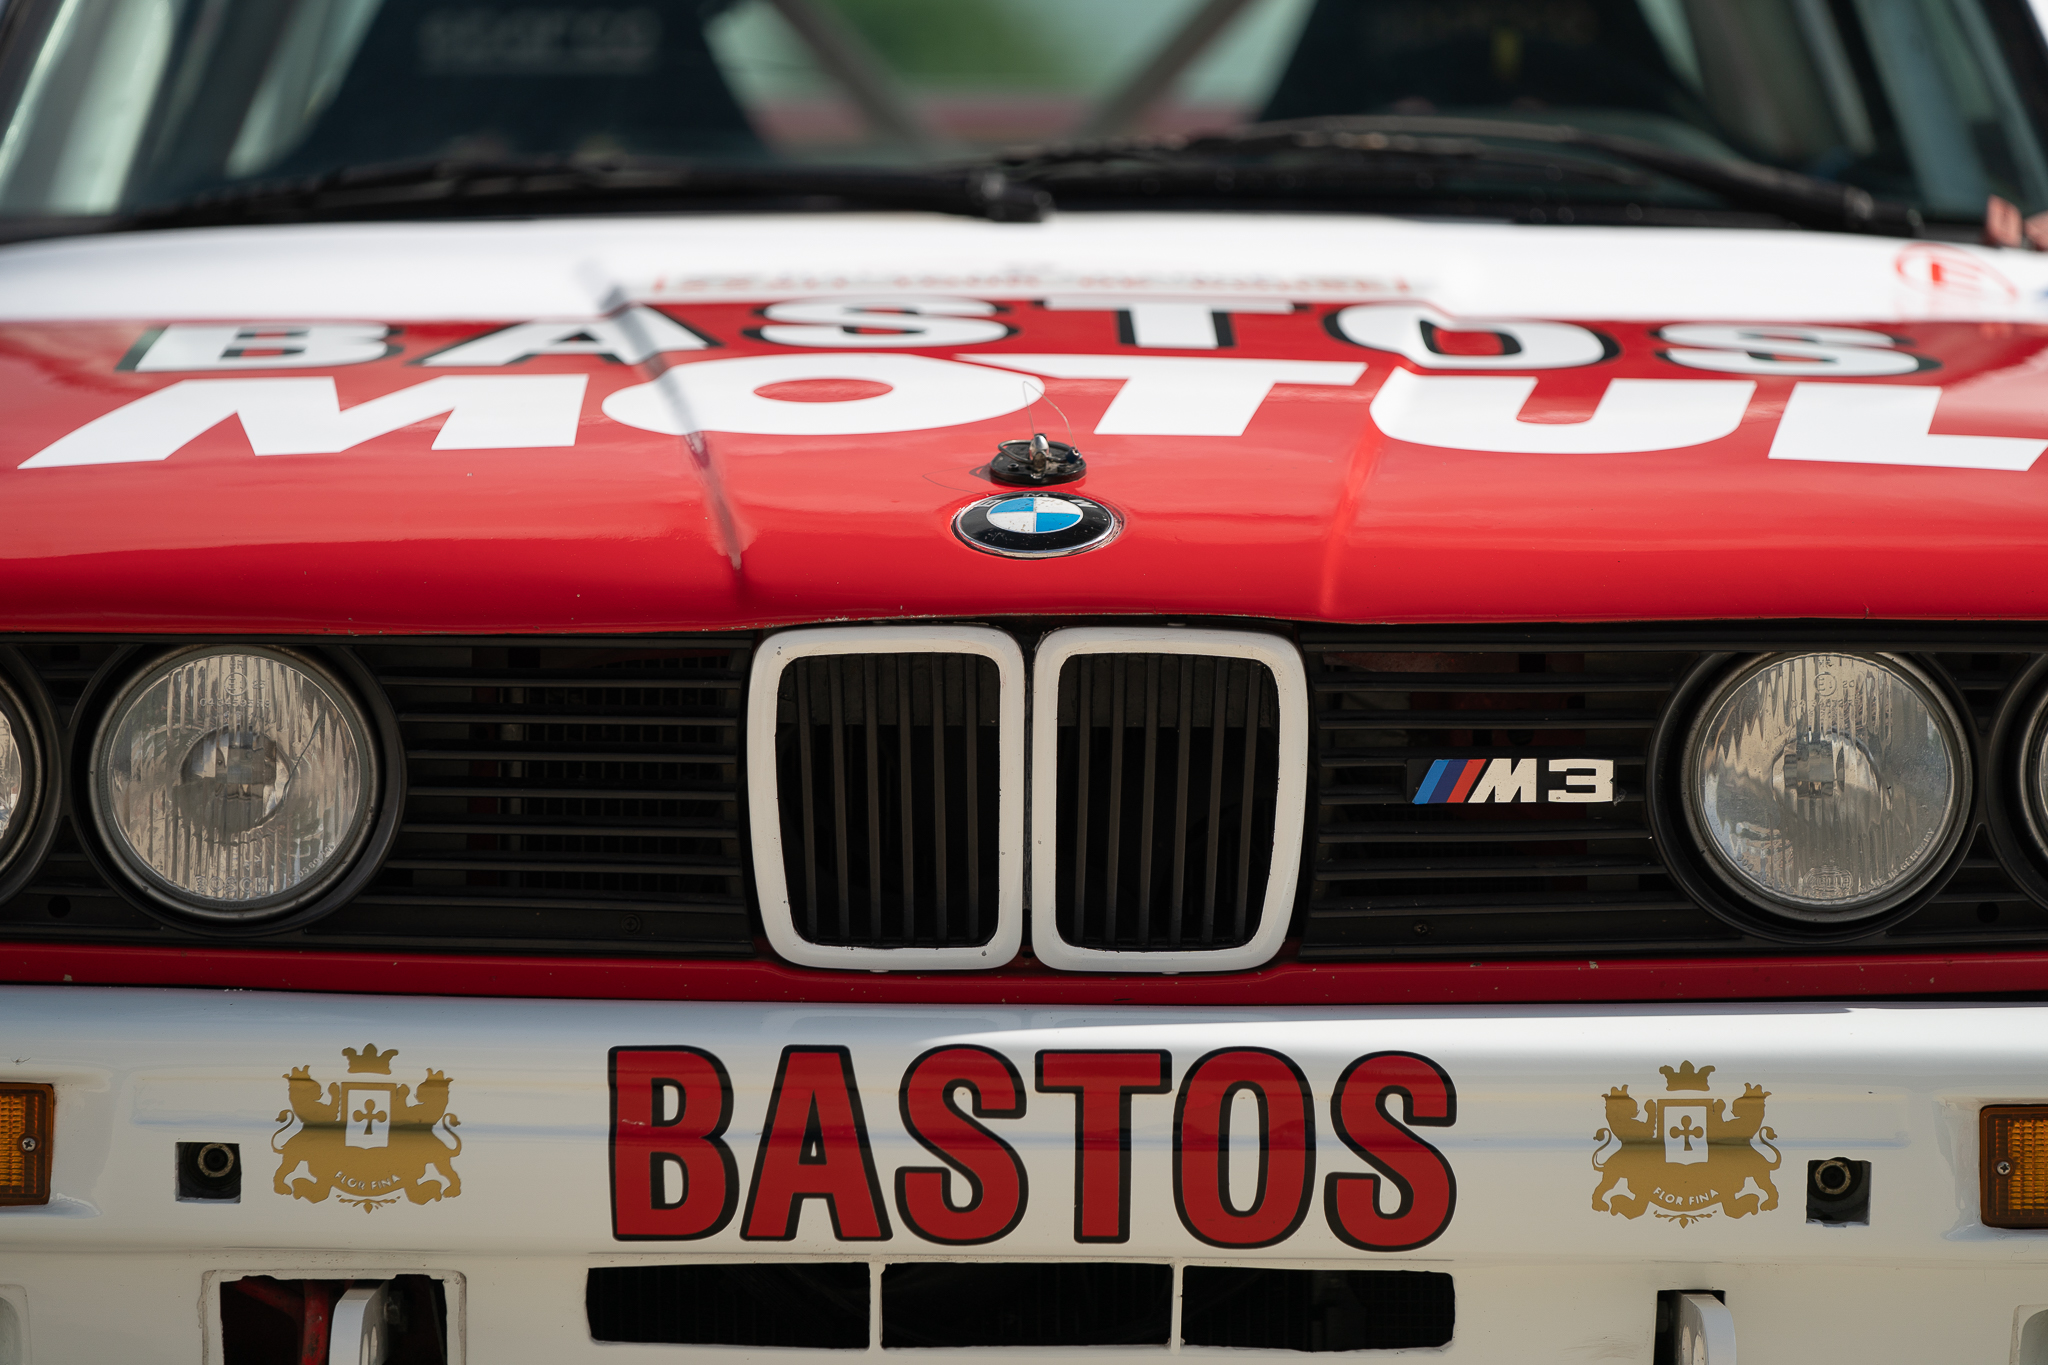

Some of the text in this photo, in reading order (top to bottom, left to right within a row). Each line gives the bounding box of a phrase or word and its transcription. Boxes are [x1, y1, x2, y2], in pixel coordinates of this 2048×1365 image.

[116, 297, 1943, 377] BASTOS
[17, 353, 2048, 471] MOTUL
[195, 875, 268, 893] BOSCH
[607, 1043, 1458, 1252] BASTOS
[334, 1170, 402, 1191] FLOR FINA
[1653, 1186, 1720, 1206] FLOR FINA
